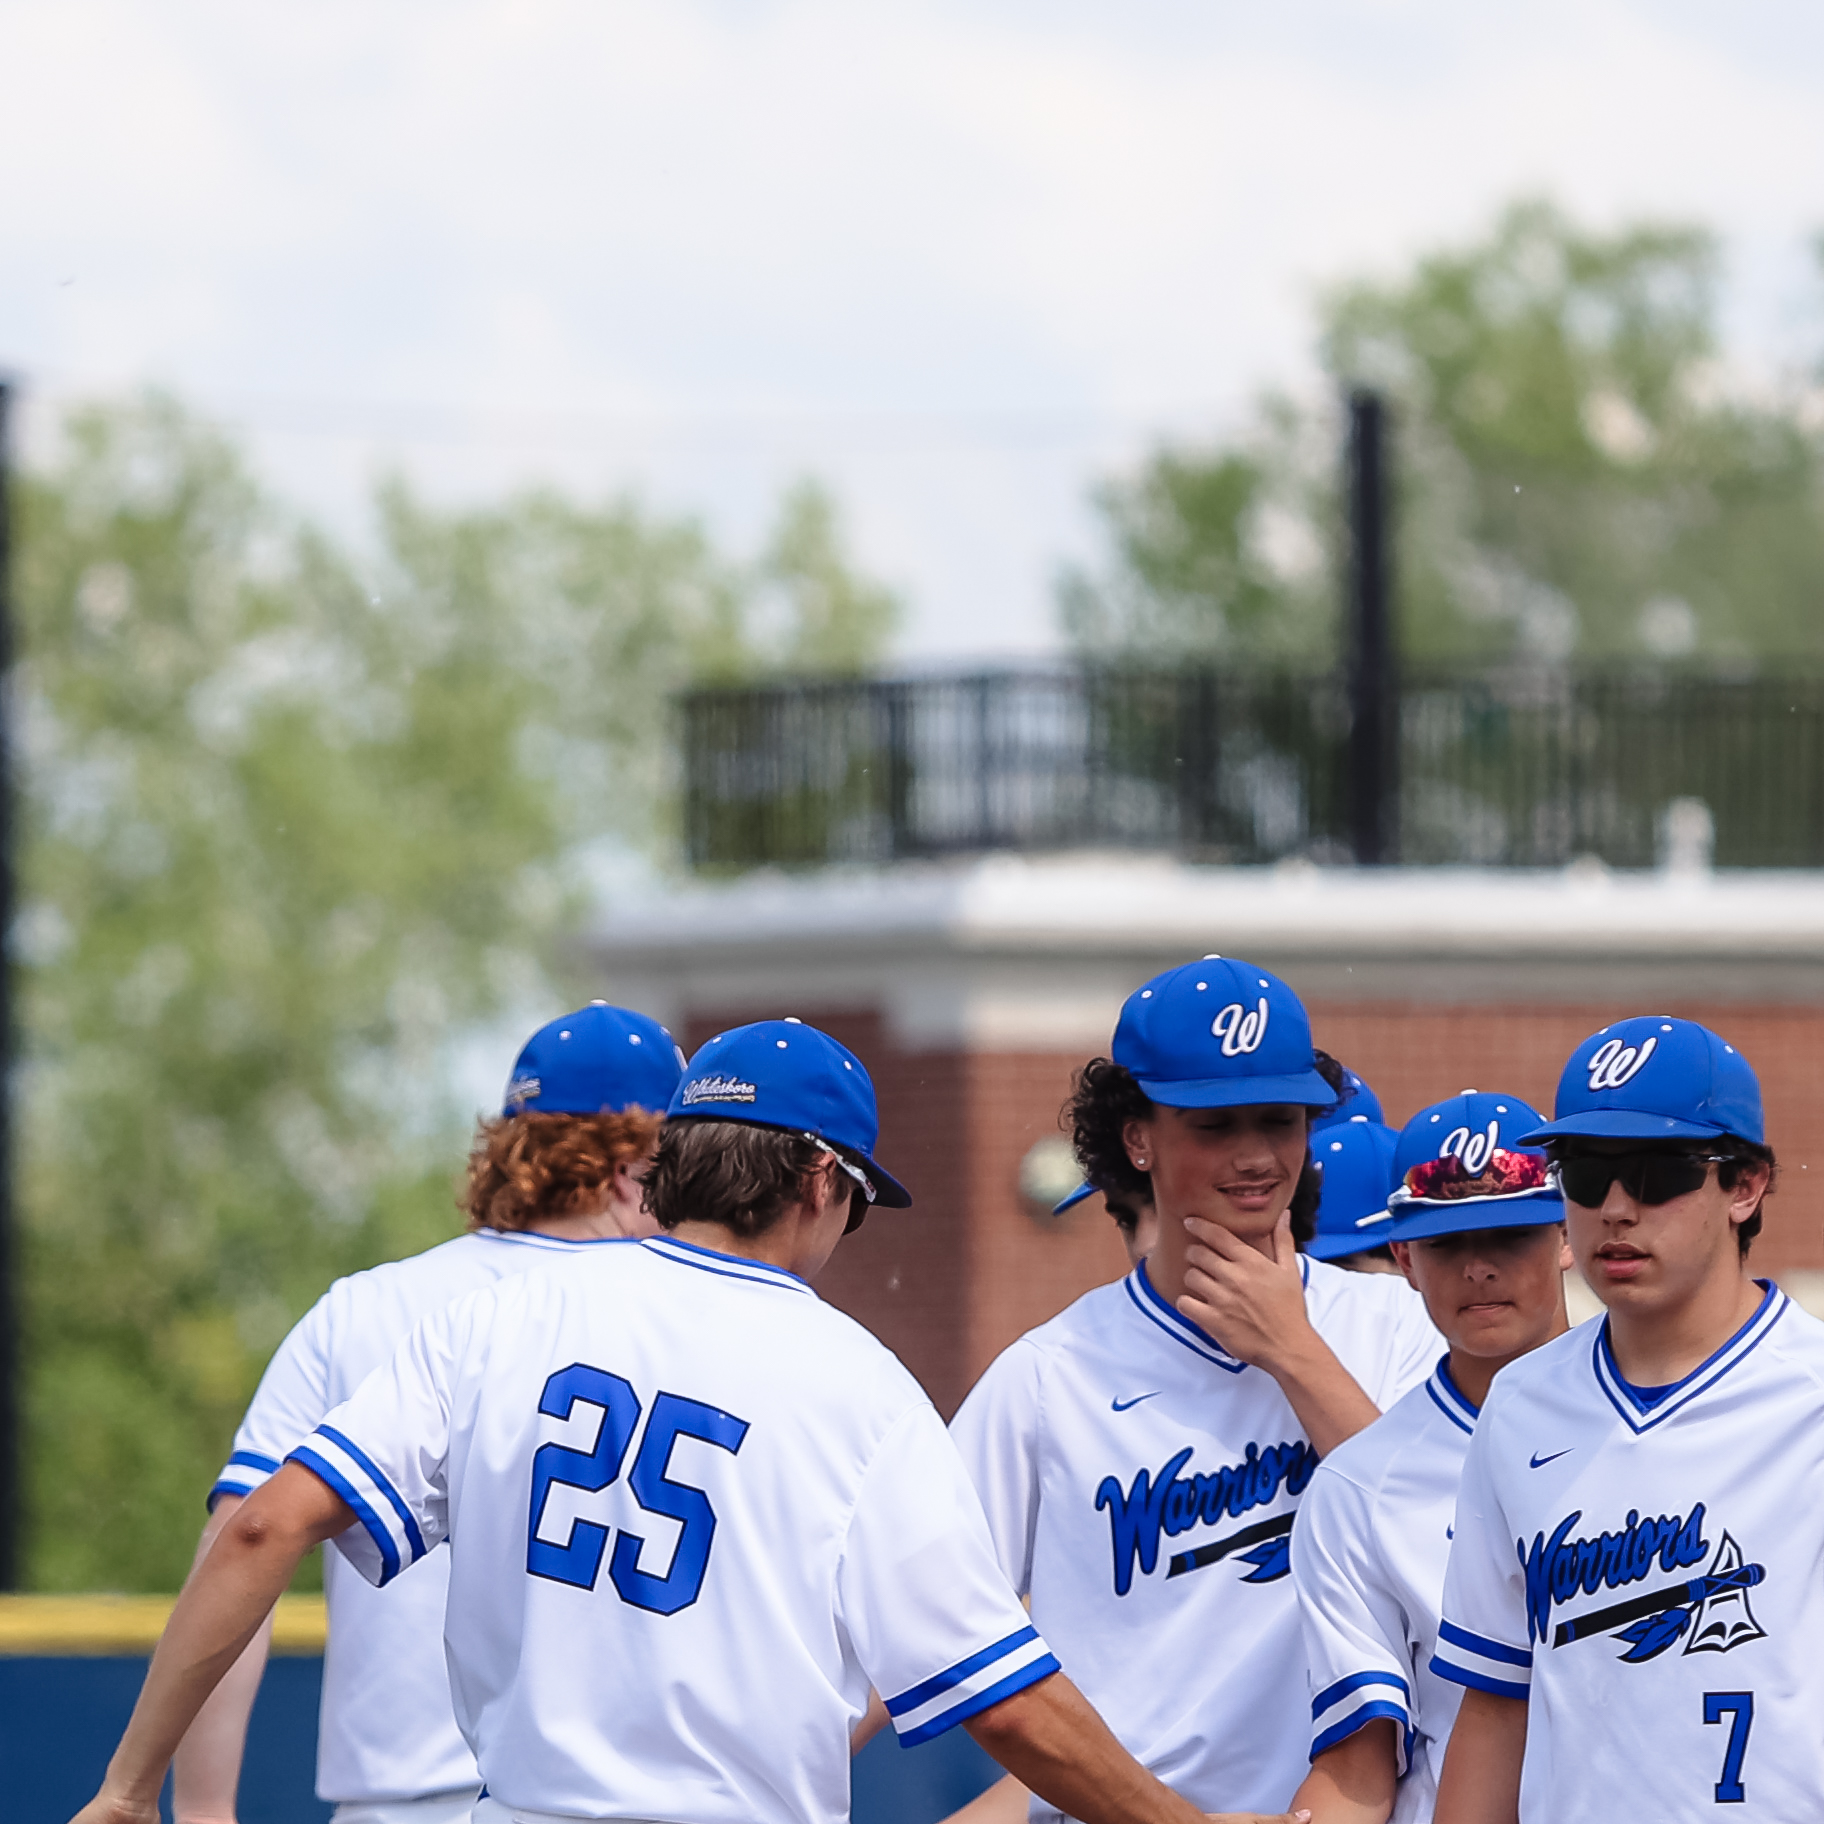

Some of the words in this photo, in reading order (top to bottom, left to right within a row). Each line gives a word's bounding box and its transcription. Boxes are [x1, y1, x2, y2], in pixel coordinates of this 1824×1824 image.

[1211, 997, 1270, 1058] W
[1588, 1036, 1658, 1092] W
[1438, 1120, 1499, 1177] W
[526, 1362, 751, 1617] 25
[1095, 1439, 1321, 1597] Warrior
[1517, 1501, 1710, 1651] Warriors
[1702, 1690, 1754, 1804] 7
